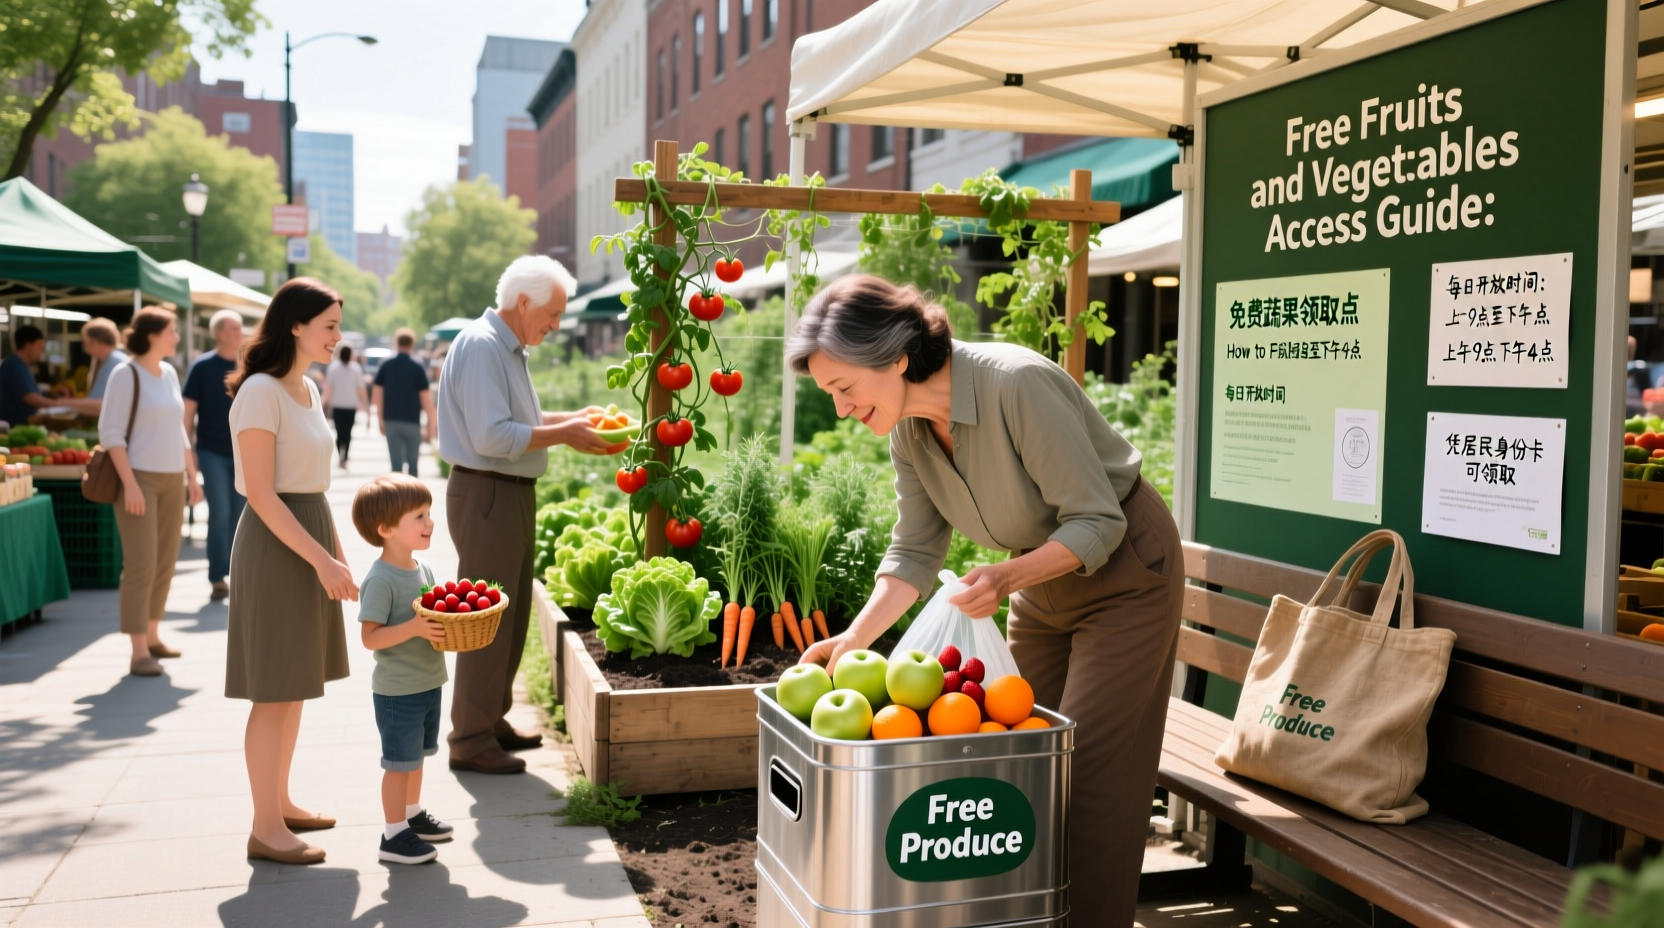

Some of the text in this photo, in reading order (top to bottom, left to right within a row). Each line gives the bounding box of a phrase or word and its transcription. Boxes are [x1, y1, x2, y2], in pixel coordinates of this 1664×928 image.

[1286, 83, 1463, 156] Free Fruits
[1250, 161, 1304, 208] and
[1264, 184, 1496, 252] Access Guide:
[1227, 343, 1251, 359] How
[1254, 343, 1266, 359] to
[1445, 432, 1544, 463] 凭居民身份卡
[1465, 462, 1516, 486] 可领取
[1279, 683, 1326, 713] Free
[1259, 704, 1335, 742] Produce
[928, 794, 994, 824] Free
[900, 827, 1023, 863] Produce
